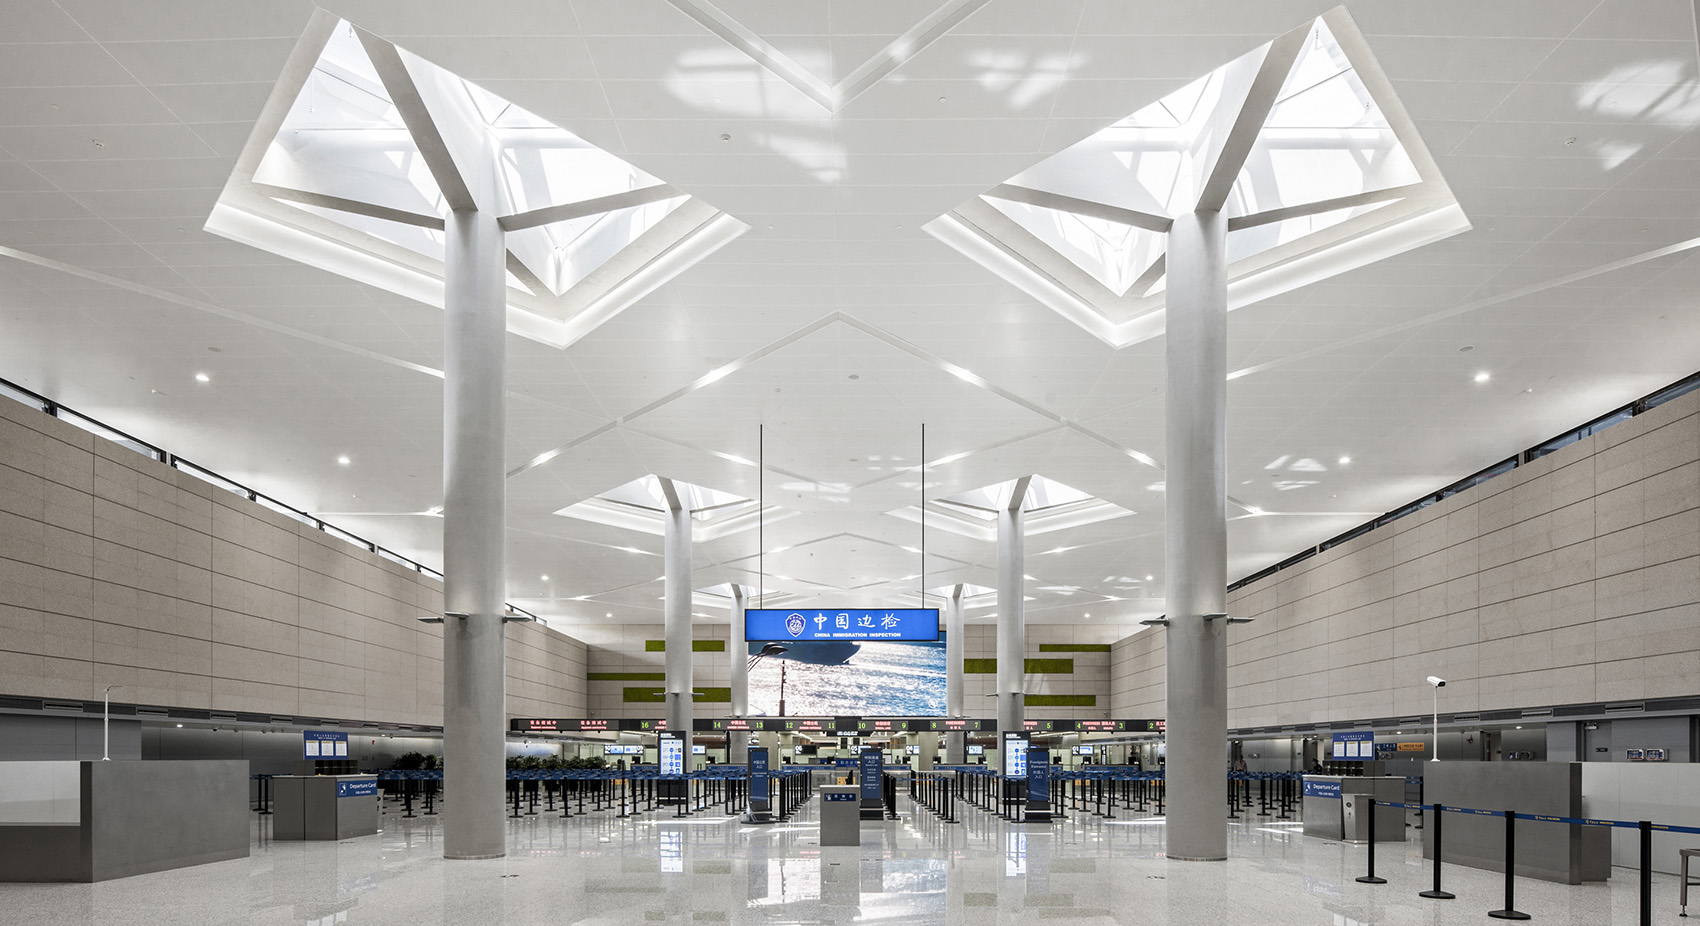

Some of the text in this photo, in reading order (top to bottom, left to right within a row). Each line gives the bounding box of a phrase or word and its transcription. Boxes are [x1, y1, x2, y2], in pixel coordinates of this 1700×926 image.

[813, 612, 901, 631] 中国边检
[641, 721, 649, 729] 16
